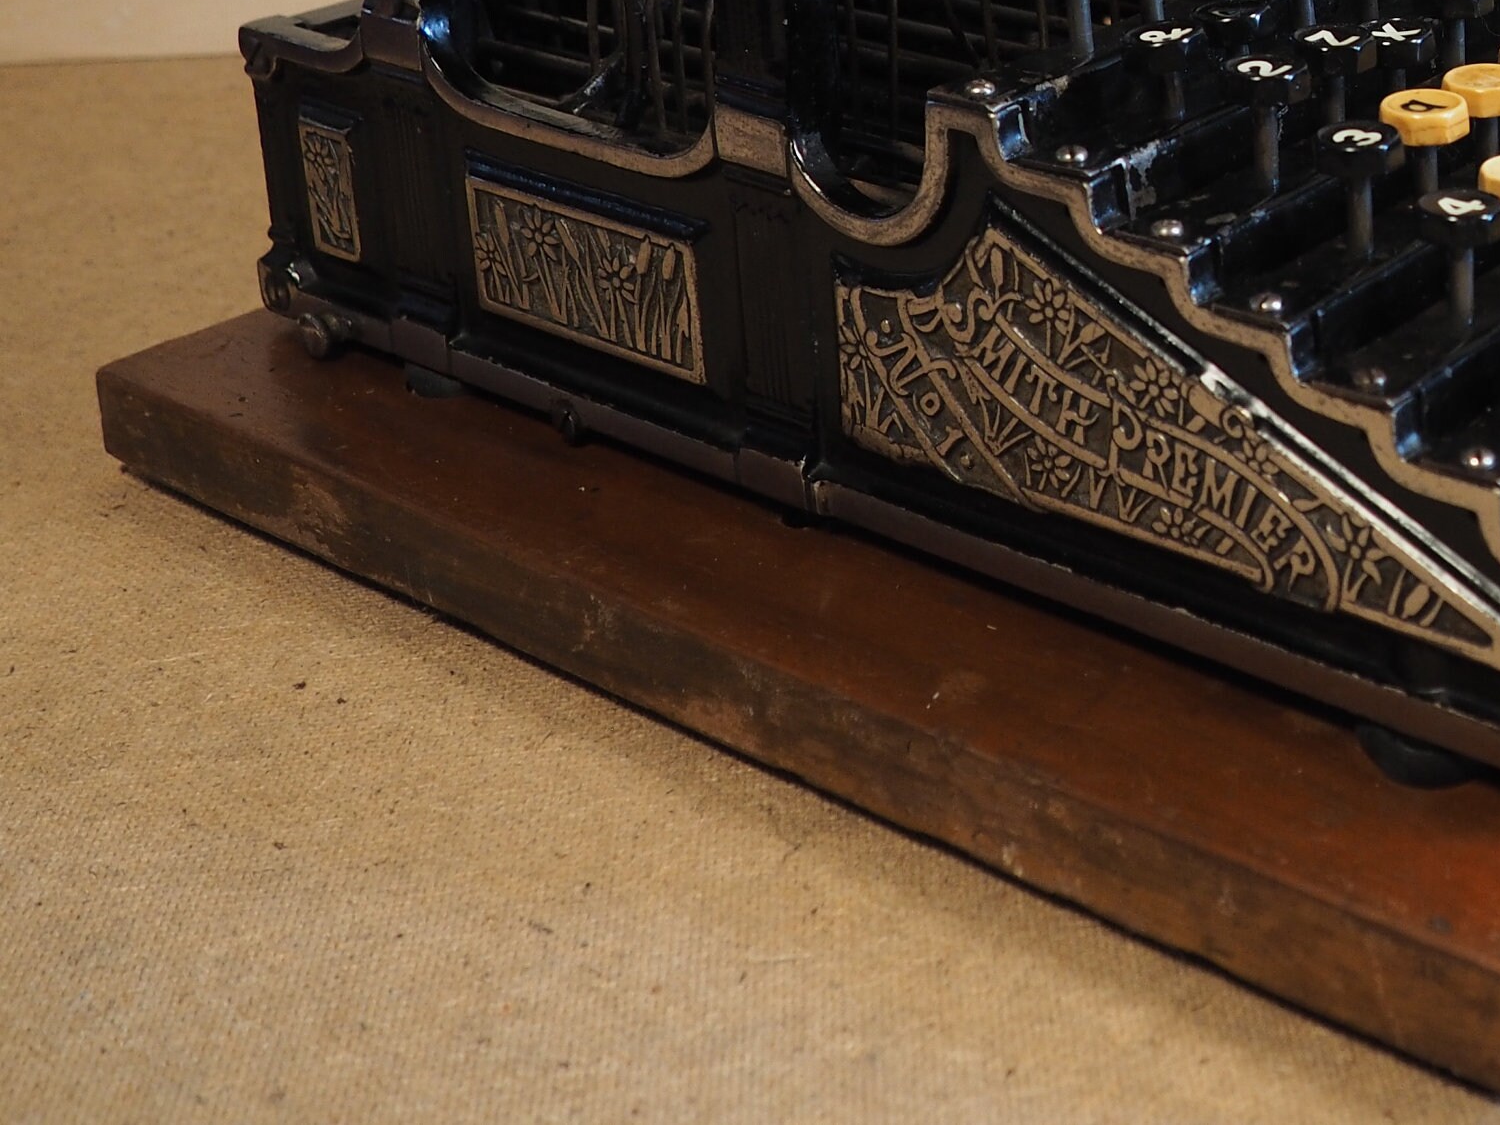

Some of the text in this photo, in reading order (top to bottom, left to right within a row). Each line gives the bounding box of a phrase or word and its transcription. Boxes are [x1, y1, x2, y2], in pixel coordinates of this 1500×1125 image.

[1304, 29, 1361, 47] Z
[1371, 22, 1421, 42] X
[1237, 60, 1294, 78] 2
[1400, 99, 1449, 113] q
[1332, 129, 1383, 147] 3
[1437, 196, 1488, 217] 4
[942, 288, 1316, 592] SMITH PREMIER
